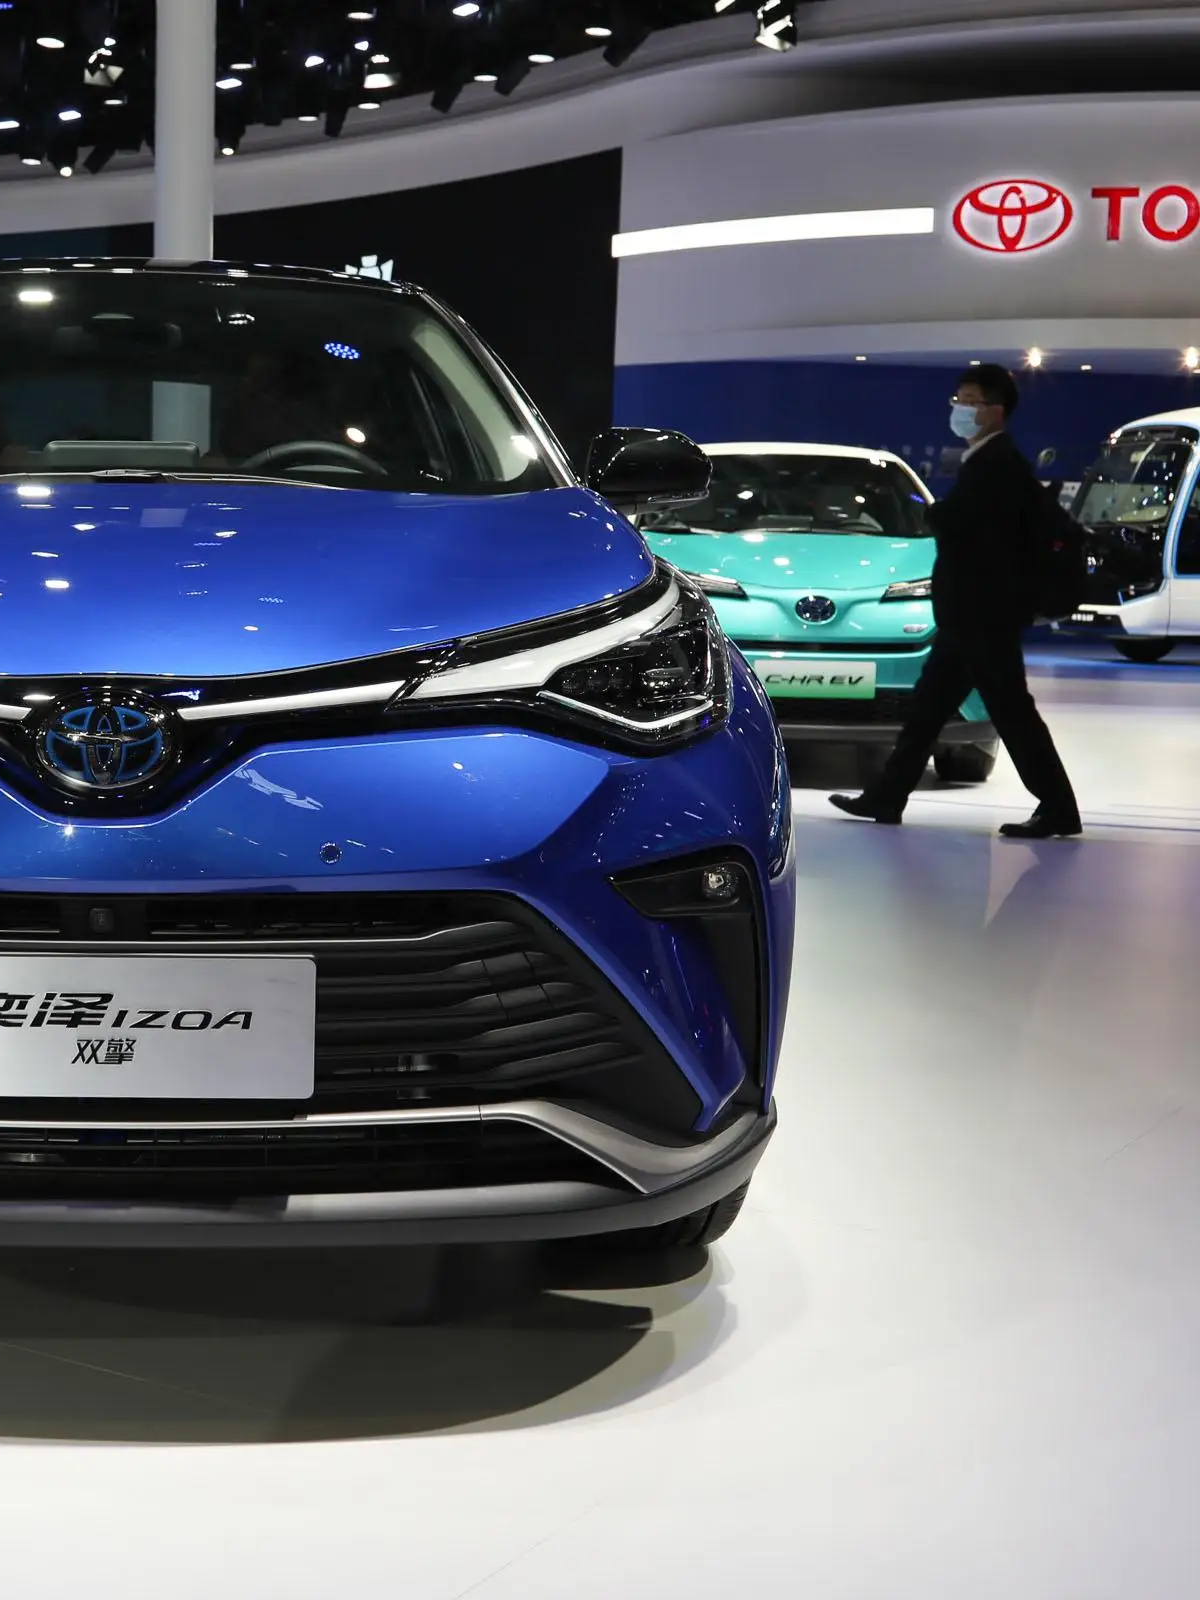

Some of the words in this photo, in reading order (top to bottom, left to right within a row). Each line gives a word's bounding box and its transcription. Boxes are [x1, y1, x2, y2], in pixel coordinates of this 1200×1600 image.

[765, 674, 825, 686] C-HR
[830, 674, 864, 685] EV
[71, 1037, 137, 1065] 双擎
